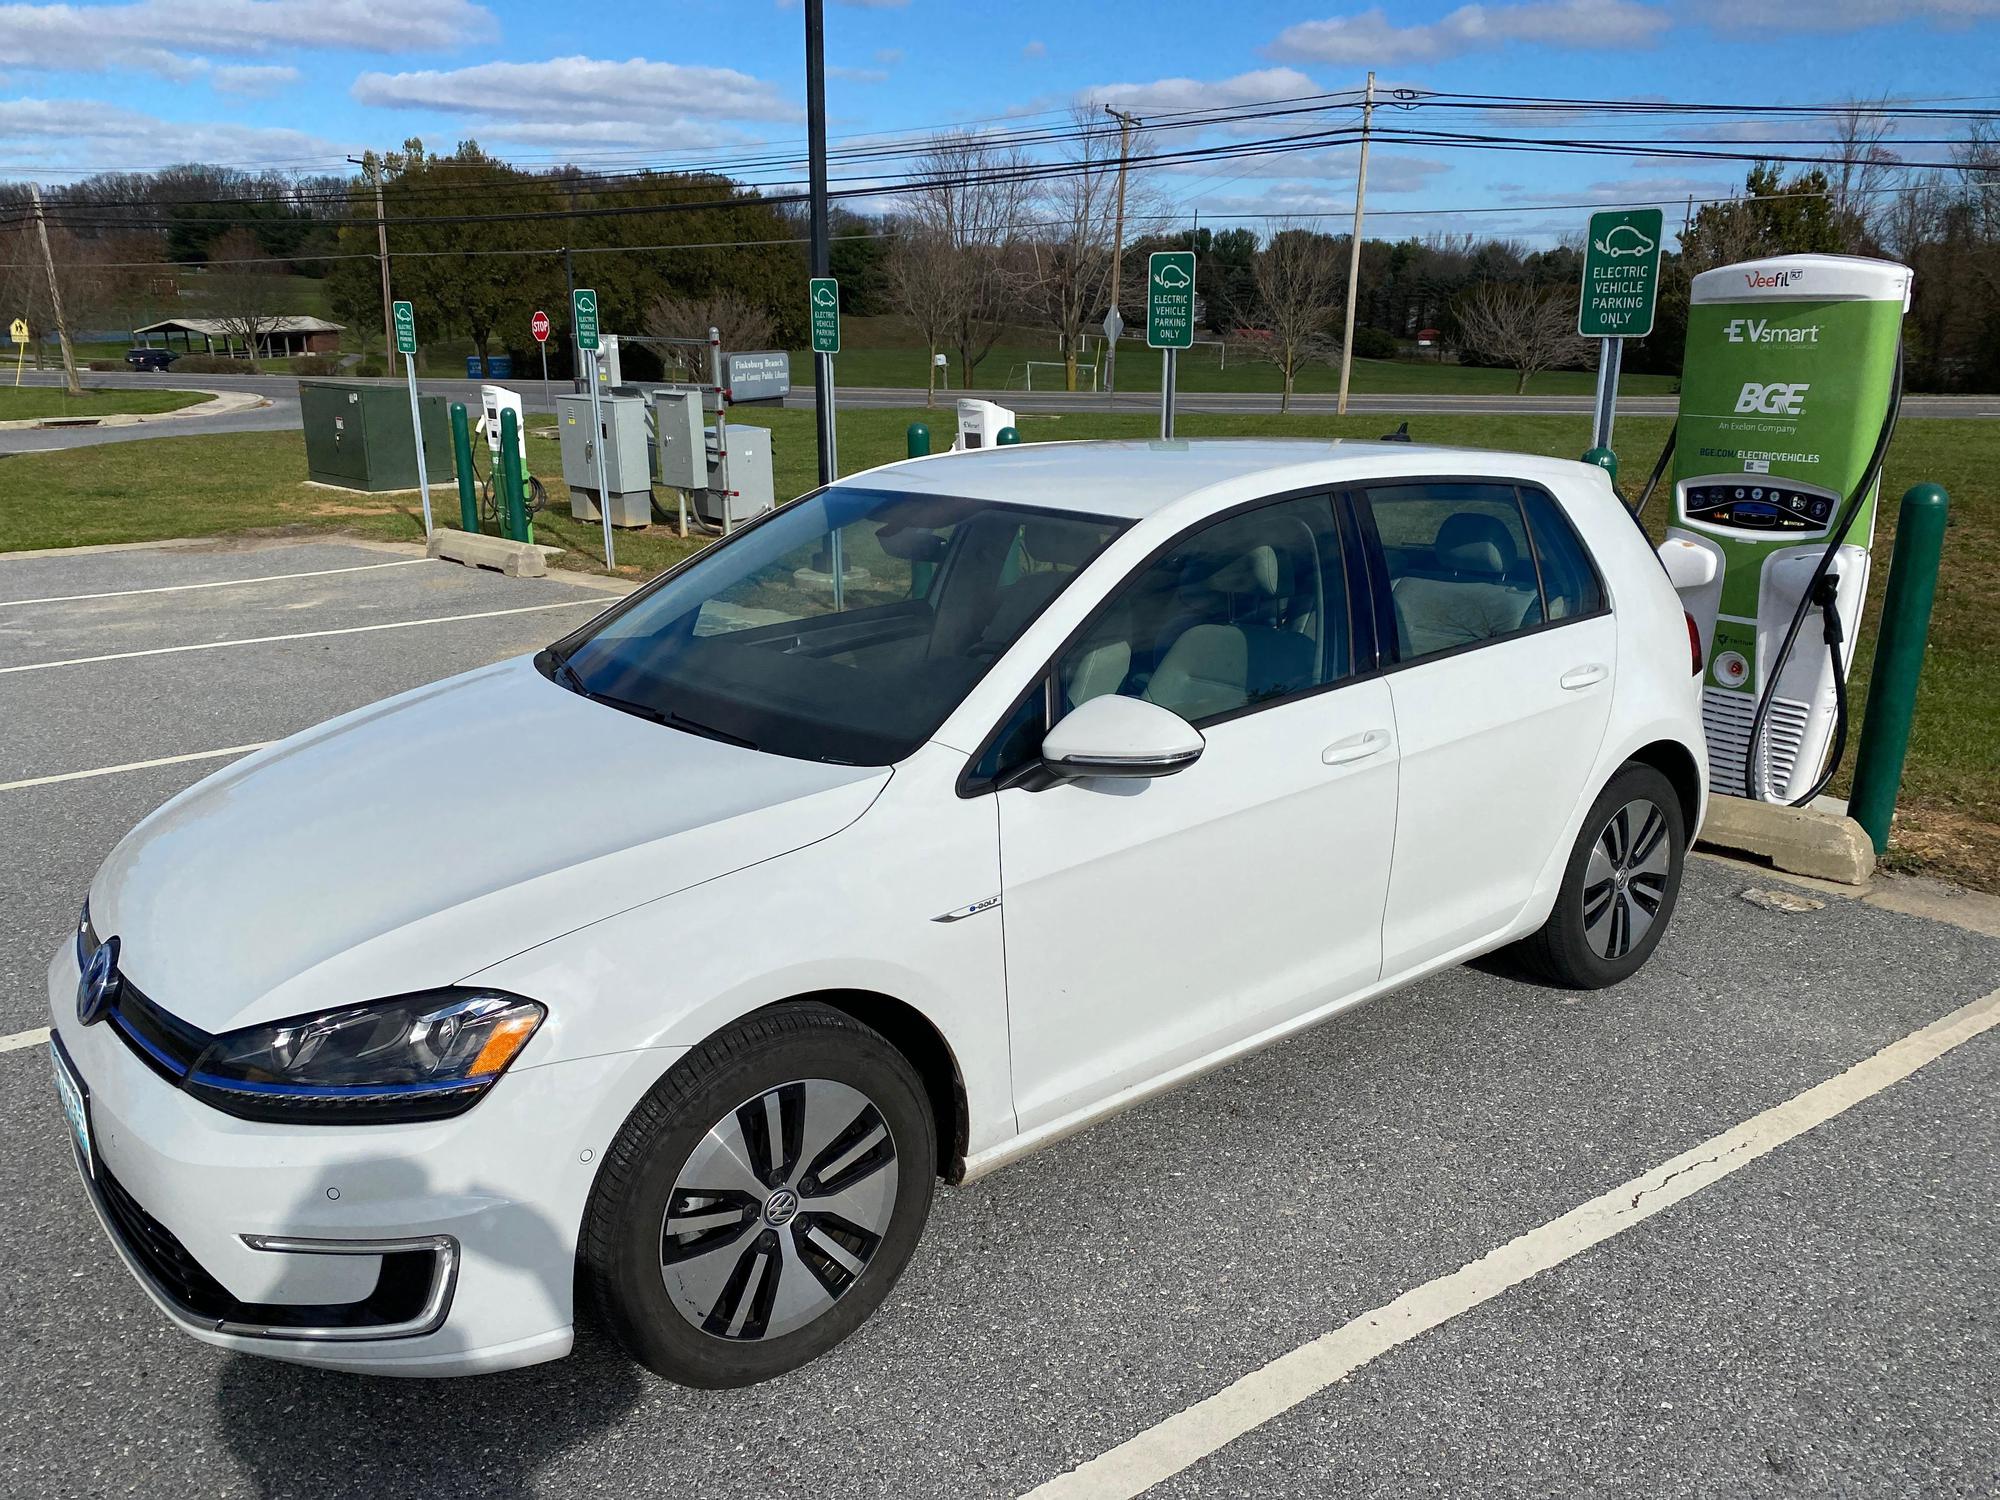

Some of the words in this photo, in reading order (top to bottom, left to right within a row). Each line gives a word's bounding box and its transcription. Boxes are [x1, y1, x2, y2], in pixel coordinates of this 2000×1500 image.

[1593, 265, 1648, 279] ELECTRIC
[1745, 270, 1790, 288] Veefil
[1595, 281, 1645, 294] VEHICLE
[1154, 294, 1188, 304] ELECTRIC
[1592, 296, 1643, 309] PARKING
[814, 311, 835, 319] ELECTRIC
[1155, 306, 1186, 316] VEHICLE
[816, 320, 835, 328] VEHICLE
[1154, 317, 1186, 327] PARKING
[1600, 312, 1632, 324] ONLY
[533, 320, 548, 332] STOP
[815, 328, 835, 336] PARKING
[1723, 319, 1819, 343] EVsmart
[1159, 329, 1180, 339] ONLY
[819, 337, 832, 345] ONLY
[735, 360, 764, 370] Finksburg
[764, 358, 784, 368] Branch
[1734, 382, 1810, 415] BGE
[1719, 422, 1729, 430] An
[1731, 422, 1756, 431] Exelon
[1758, 423, 1797, 435] Company
